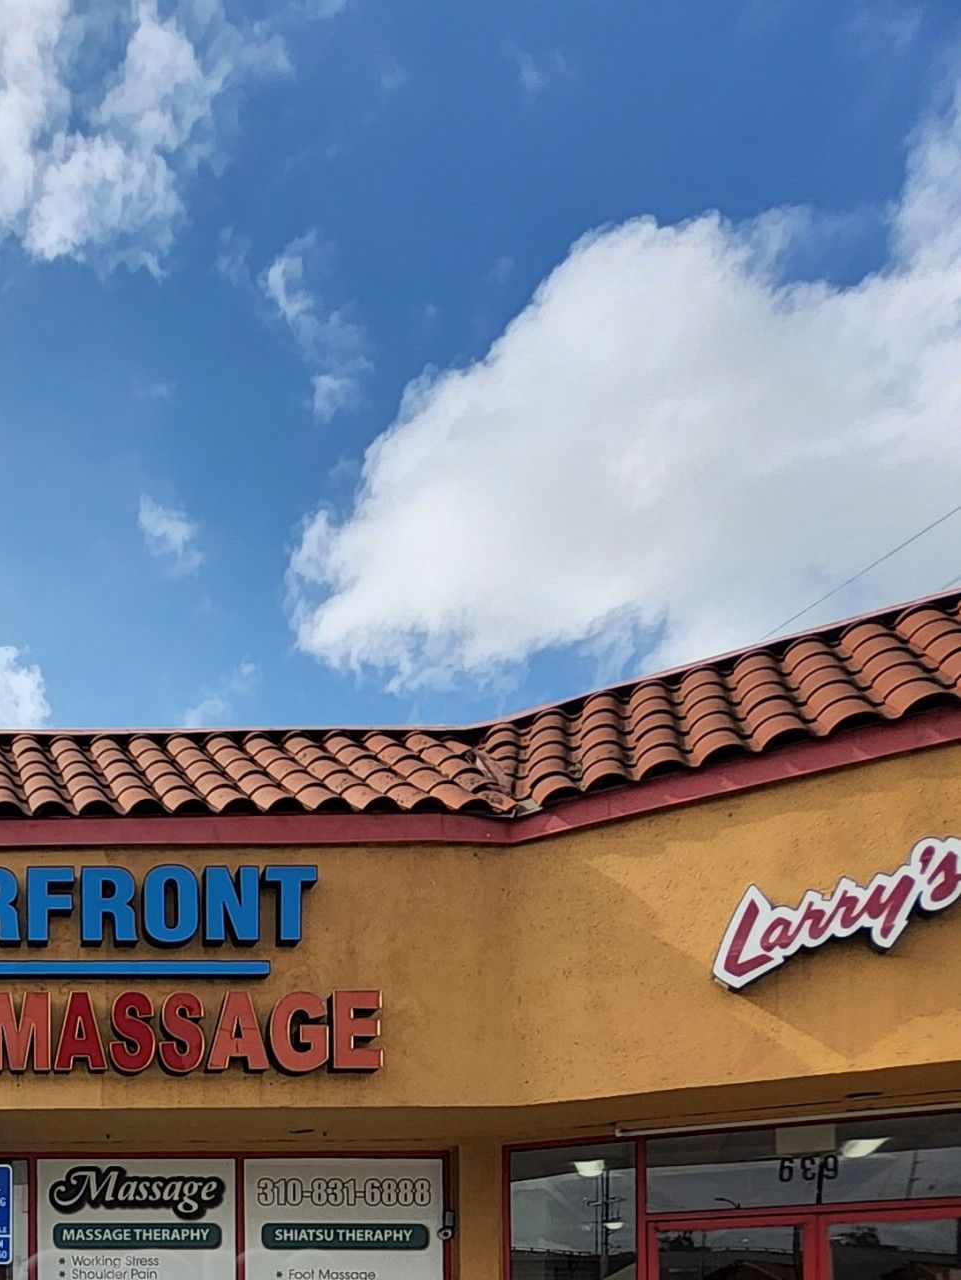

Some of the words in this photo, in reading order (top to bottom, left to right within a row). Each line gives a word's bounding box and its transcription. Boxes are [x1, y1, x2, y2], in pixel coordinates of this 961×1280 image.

[719, 840, 961, 983] Larry's
[50, 1167, 223, 1219] Massage
[257, 1177, 432, 1206] 310-831-6888
[62, 1228, 132, 1241] MASSAGE
[135, 1228, 210, 1241] THERAPHY
[274, 1229, 334, 1242] SHIATSU
[338, 1229, 413, 1242] THERAPHY
[72, 1255, 121, 1268] Working
[125, 1255, 159, 1266] Stress
[72, 1268, 128, 1280] Shoulder
[130, 1268, 158, 1280] Pain
[288, 1269, 315, 1280] Foot
